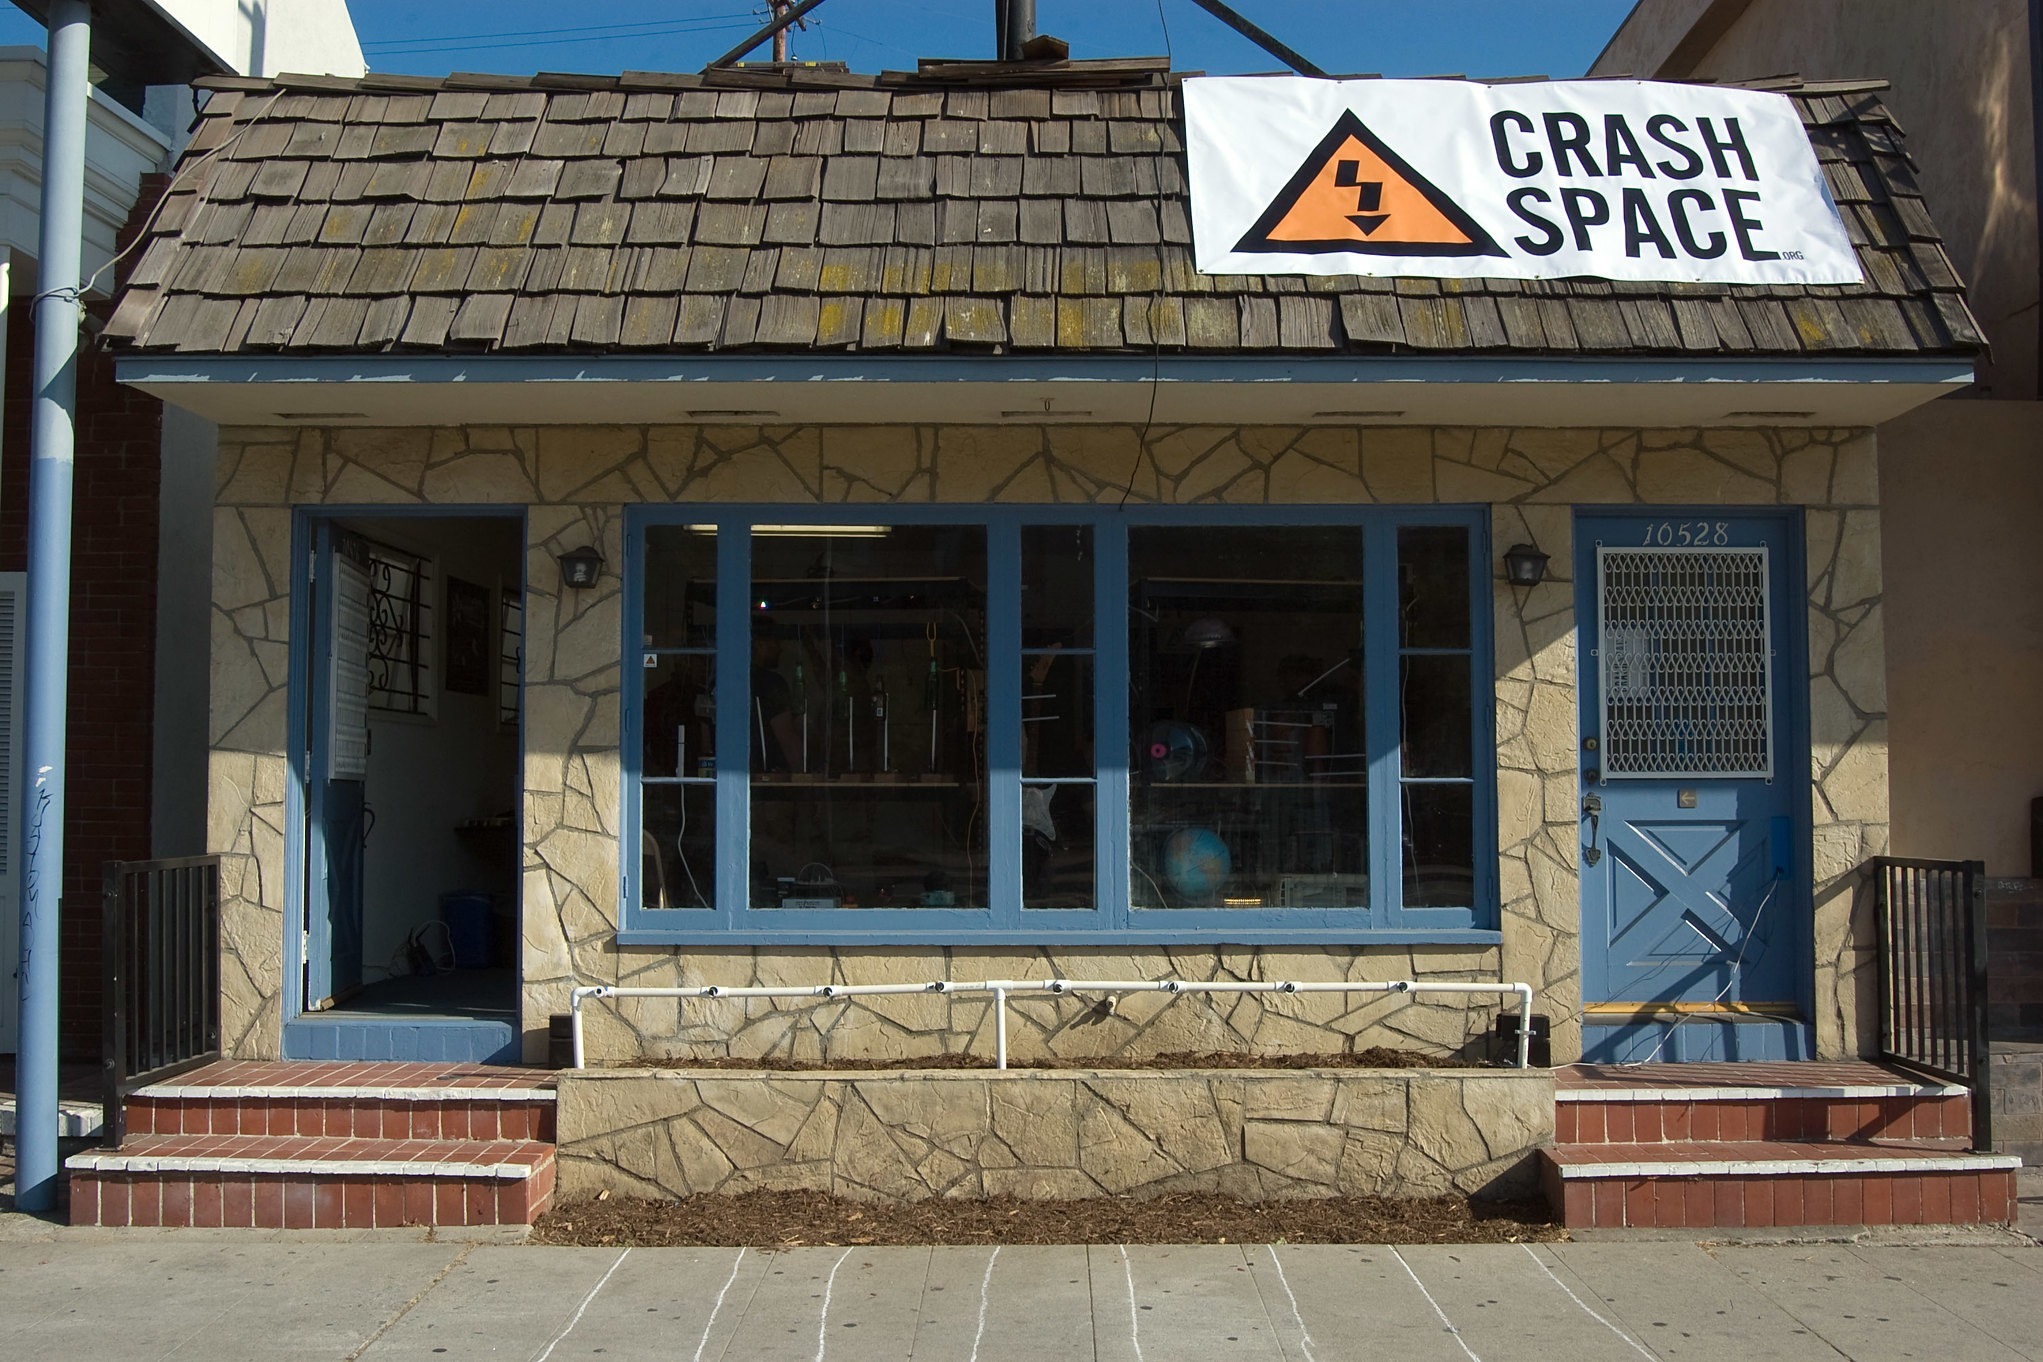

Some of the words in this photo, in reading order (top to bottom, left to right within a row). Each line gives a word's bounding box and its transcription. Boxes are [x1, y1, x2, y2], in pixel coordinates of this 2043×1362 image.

[1490, 110, 1760, 181] CRASH
[1506, 187, 1782, 262] SPACE
[1642, 521, 1729, 546] 10528
